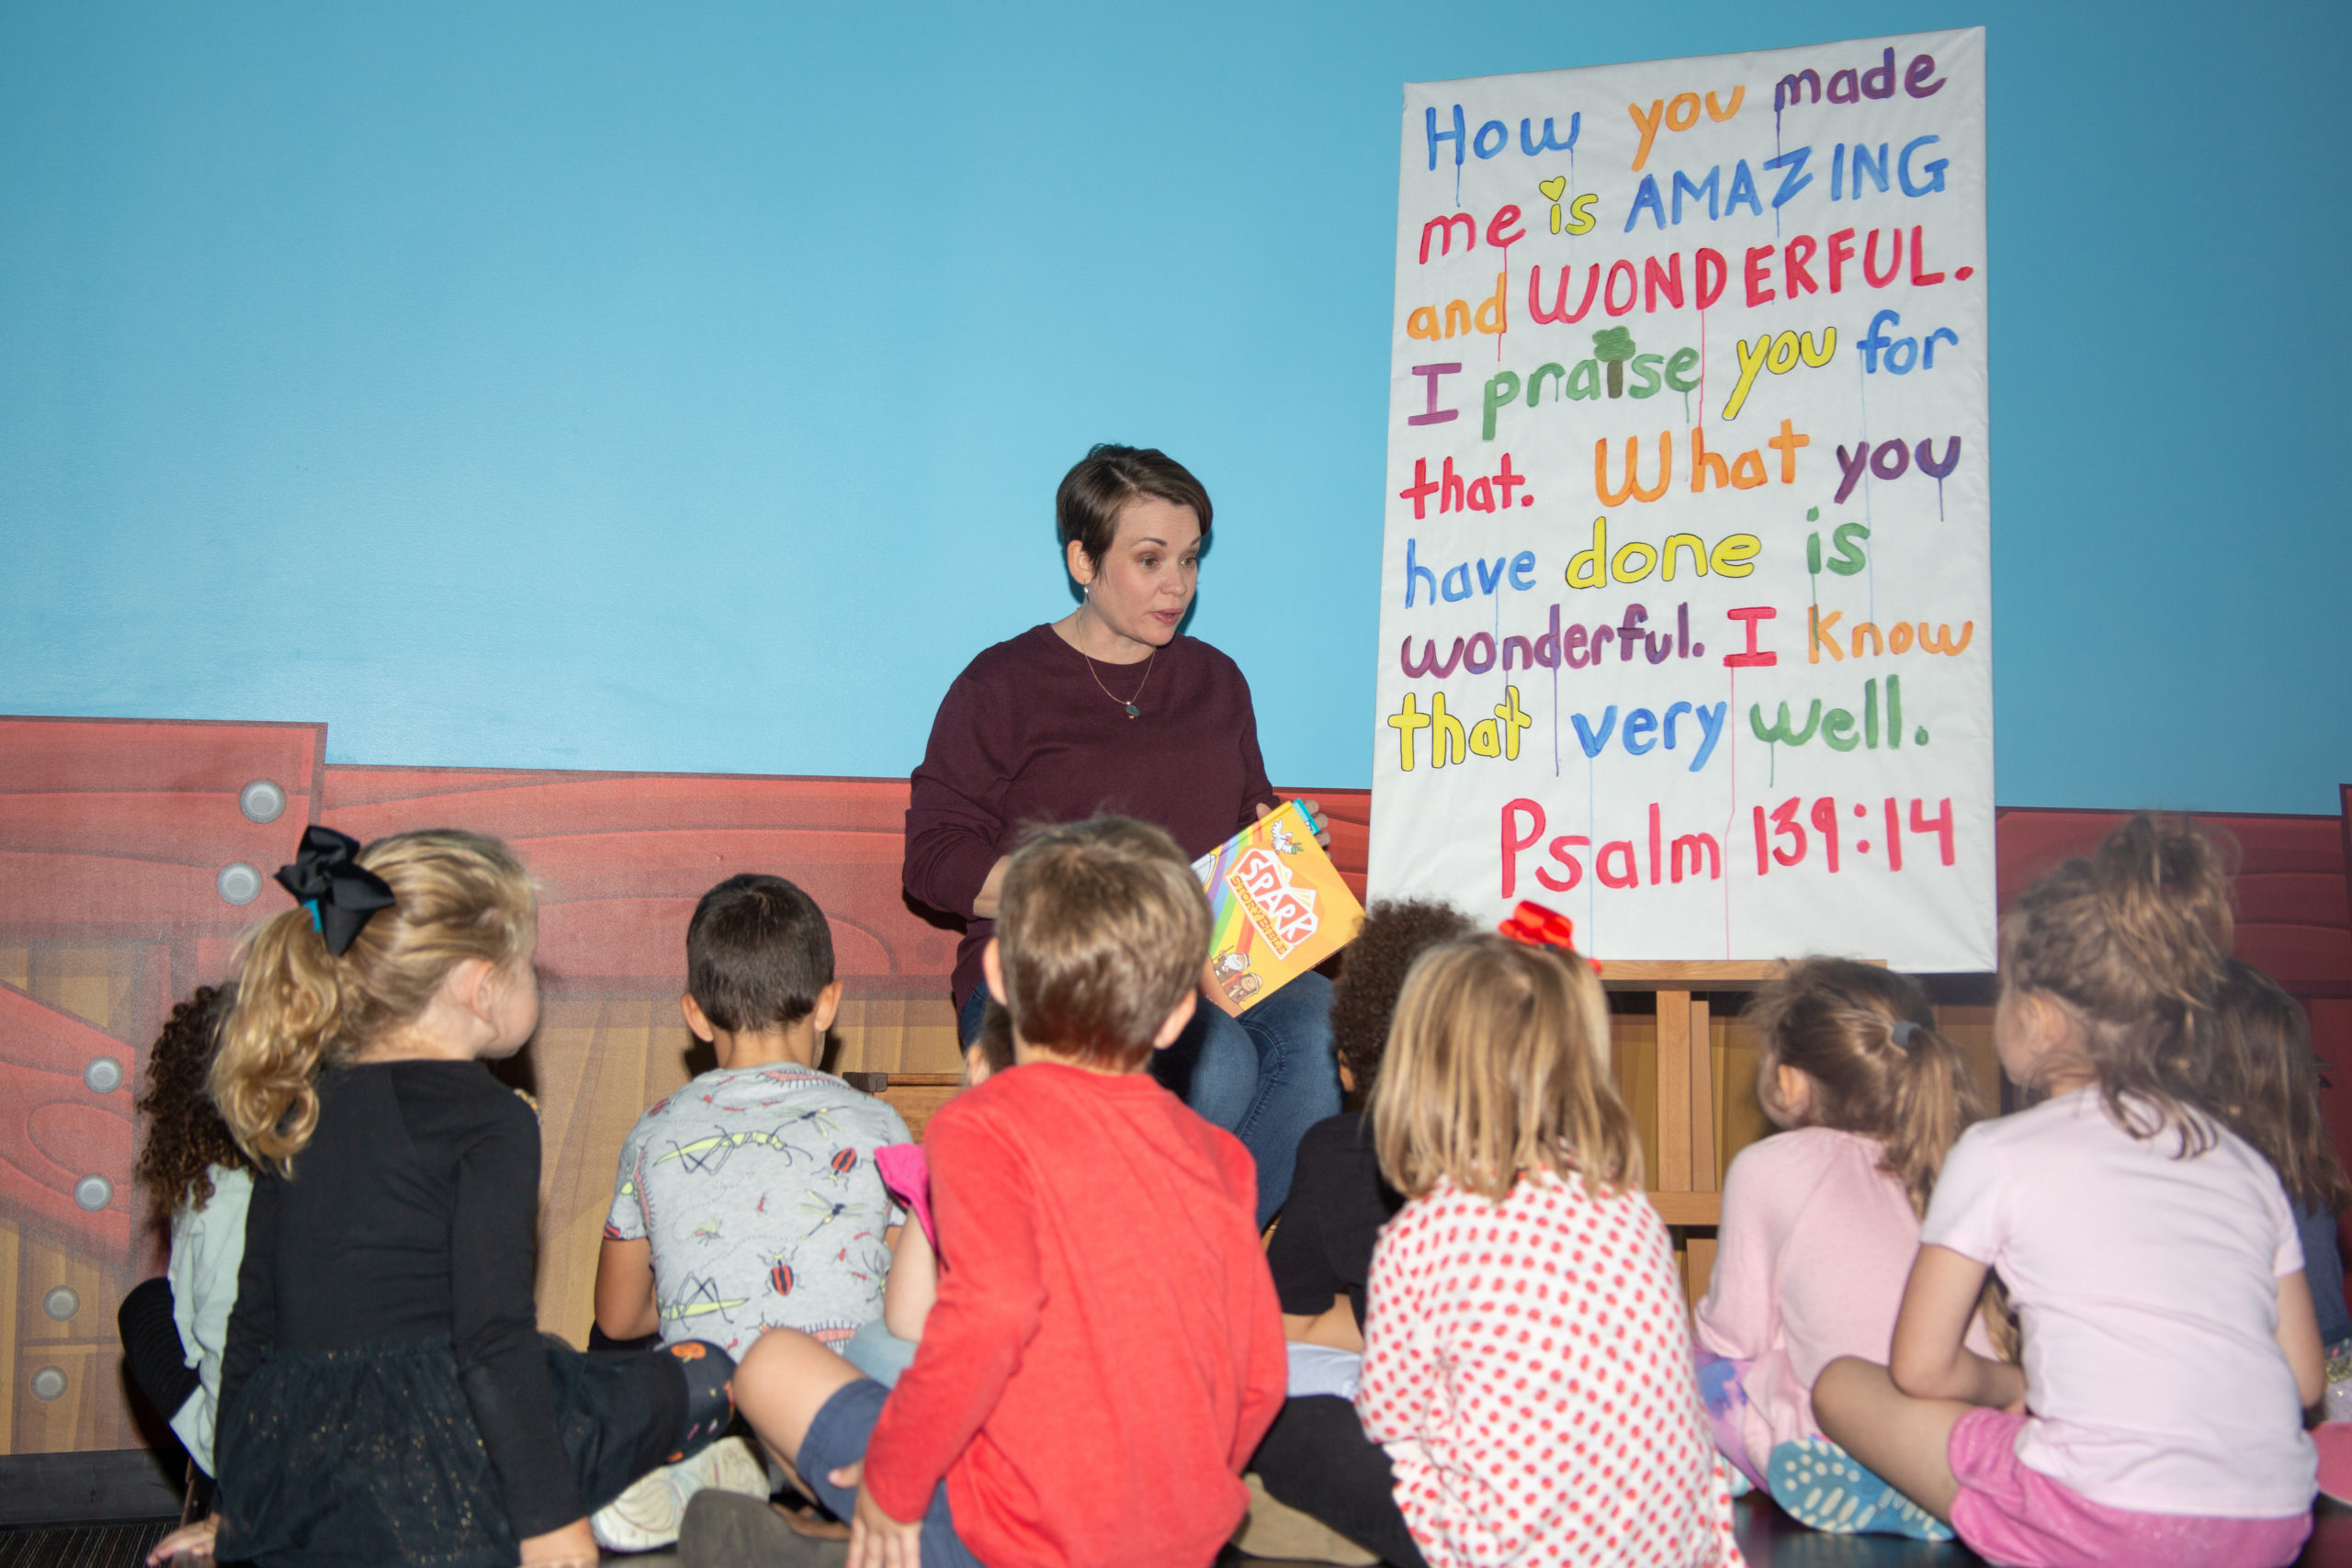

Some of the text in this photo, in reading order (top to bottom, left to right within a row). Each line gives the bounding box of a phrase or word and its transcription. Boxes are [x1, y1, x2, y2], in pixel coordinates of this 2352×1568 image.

[1426, 47, 1947, 172] How you made
[1419, 135, 1950, 264] me is AMAZING
[1407, 225, 1973, 342] and WONDERFUL.
[1408, 362, 1462, 425] I
[1722, 326, 1836, 421] you
[1856, 310, 1958, 375] for
[1400, 419, 1961, 519] that. What you
[1405, 506, 1870, 609] have done is
[1400, 602, 1705, 679] wonderful.
[1723, 606, 1777, 668] I
[1387, 674, 1929, 772] that very well.
[1501, 796, 1955, 898] Psalm 139:14
